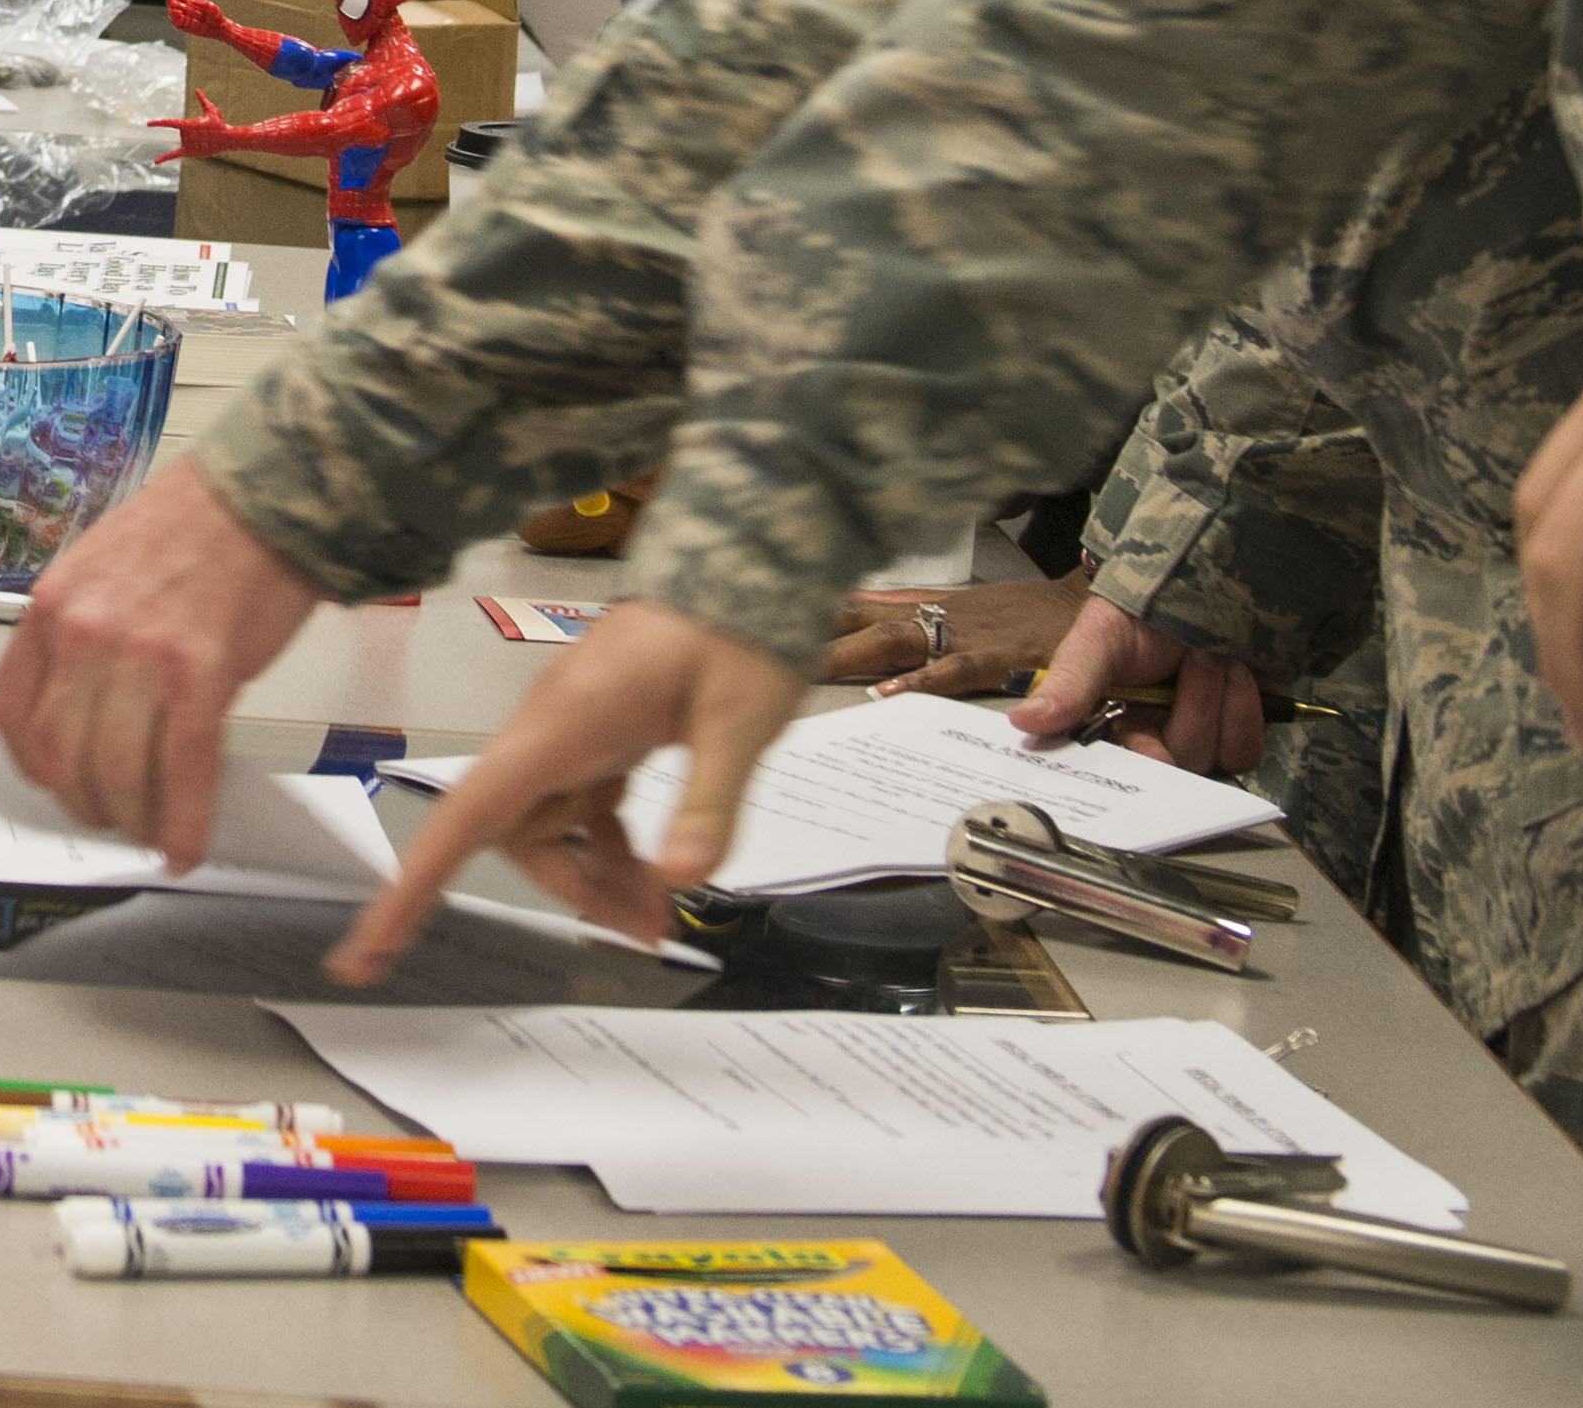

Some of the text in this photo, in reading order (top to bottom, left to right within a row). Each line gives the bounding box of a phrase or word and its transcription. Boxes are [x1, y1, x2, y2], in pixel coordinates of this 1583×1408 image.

[29, 263, 66, 278] Day
[63, 262, 99, 285] Every
[104, 257, 135, 276] Good
[136, 264, 166, 284] Have
[96, 278, 130, 294] Day
[169, 265, 201, 296] How To
[545, 1245, 850, 1271] Crayola
